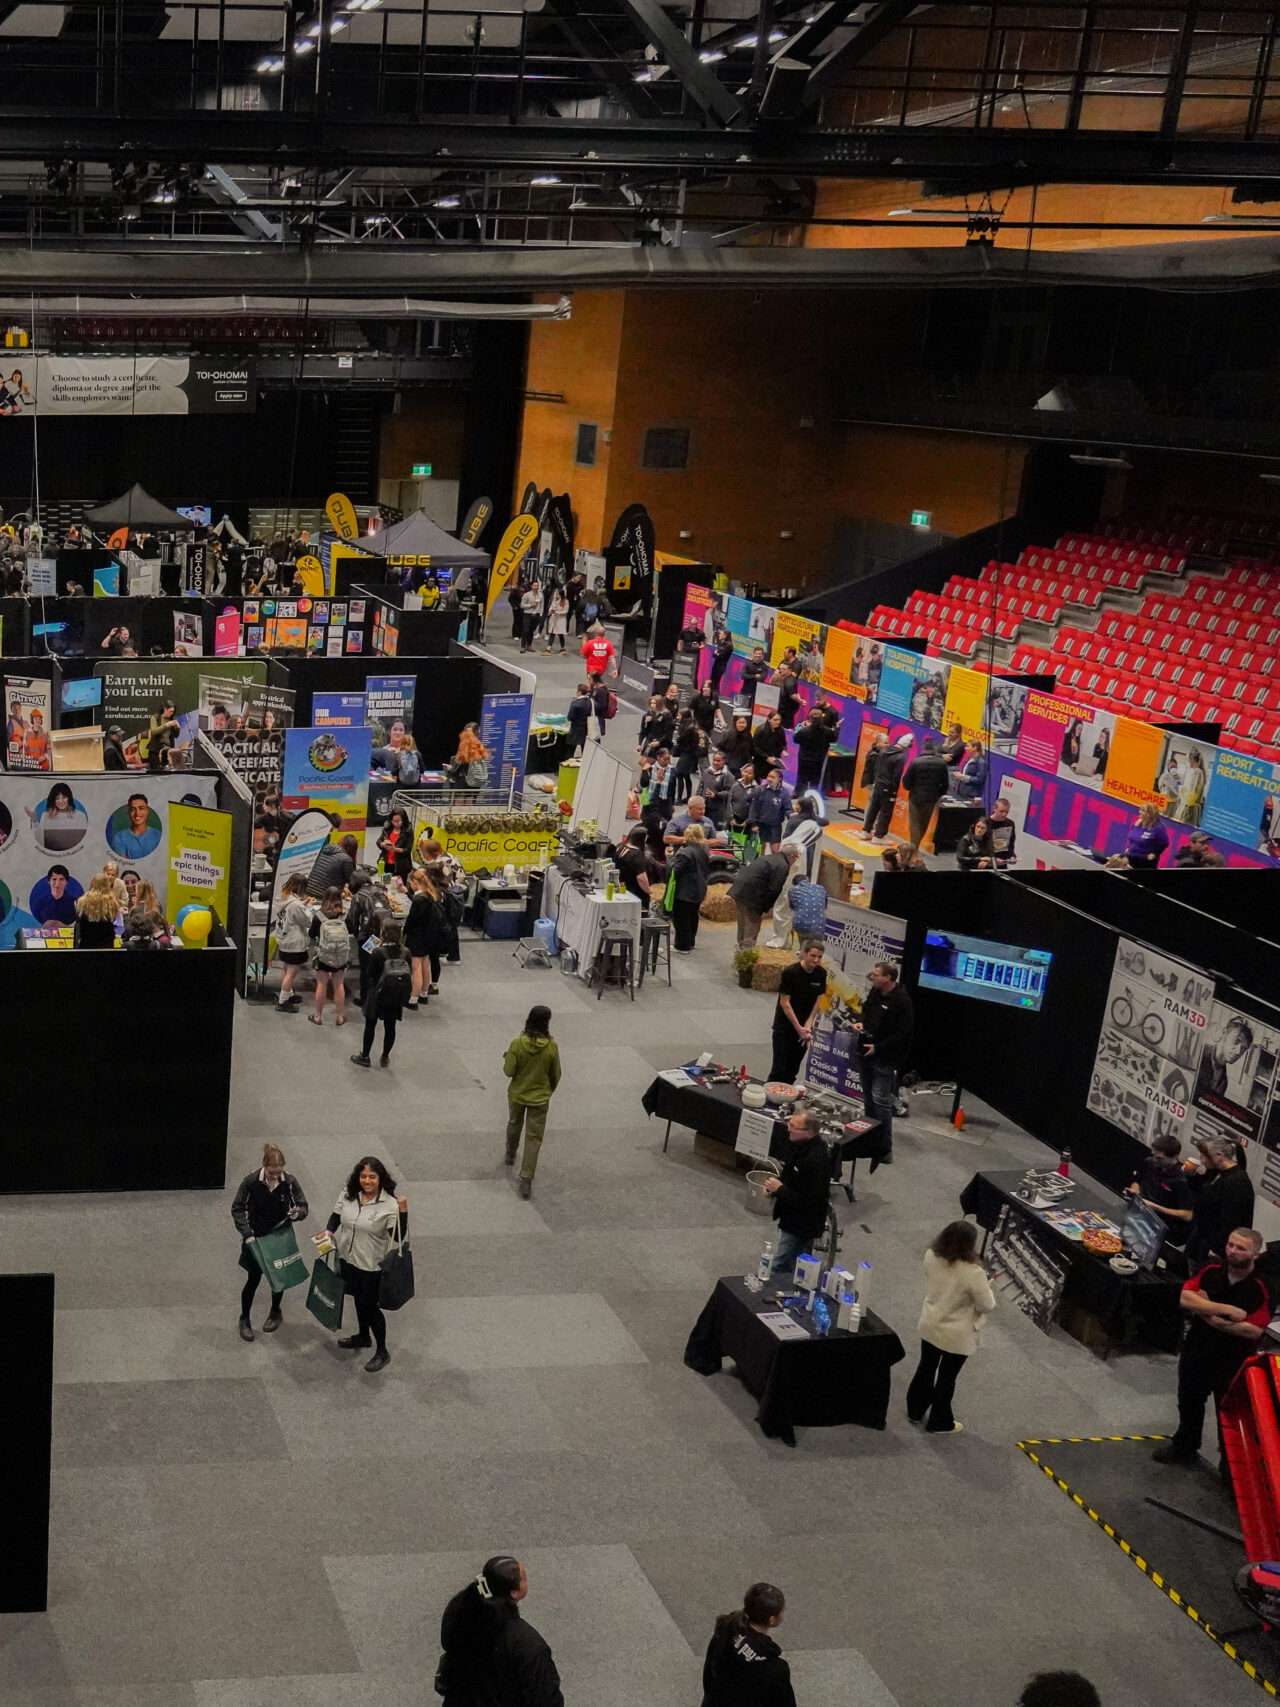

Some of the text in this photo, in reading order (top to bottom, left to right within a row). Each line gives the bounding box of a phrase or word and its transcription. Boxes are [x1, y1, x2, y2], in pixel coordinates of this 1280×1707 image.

[52, 374, 80, 382] Choose
[91, 375, 111, 383] study
[119, 374, 158, 382] certficate,
[52, 384, 83, 393] diploma
[93, 384, 119, 392] degree
[72, 395, 110, 403] employers
[331, 500, 353, 538] QUB
[464, 503, 489, 544] UBE
[496, 522, 533, 577] QUBE
[384, 554, 430, 567] UBE
[824, 666, 844, 678] TRADES
[885, 659, 928, 678] HOSPITALITY
[105, 674, 173, 686] Earn while
[822, 675, 866, 698] CONSTRUCTION
[9, 691, 46, 706] GATEWAY
[104, 685, 163, 698] you learn
[315, 708, 330, 717] OUR
[1028, 703, 1069, 725] SERVICES
[1029, 693, 1093, 721] PROFESSIONAL
[315, 717, 351, 726] CAMPUSES
[947, 710, 955, 719] IT
[214, 741, 279, 754] RACTICAL
[1220, 753, 1255, 771] SPORT
[298, 774, 354, 783] Pacific Coast
[1106, 778, 1165, 807] HEALTHCARE
[182, 825, 194, 833] Find
[204, 829, 215, 837] how
[186, 831, 197, 839] you
[446, 838, 554, 852] Pacific Coast
[118, 858, 136, 867] Fighter
[184, 851, 207, 862] make
[175, 860, 220, 877] epic things
[181, 874, 213, 886] happen
[844, 924, 883, 942] EMBRACE
[839, 931, 886, 951] ADVANCED
[826, 936, 897, 964] MANUFACTURING
[1164, 998, 1206, 1028] RAM3D
[810, 1057, 832, 1071] Oasis
[1145, 1086, 1186, 1119] RAM3D
